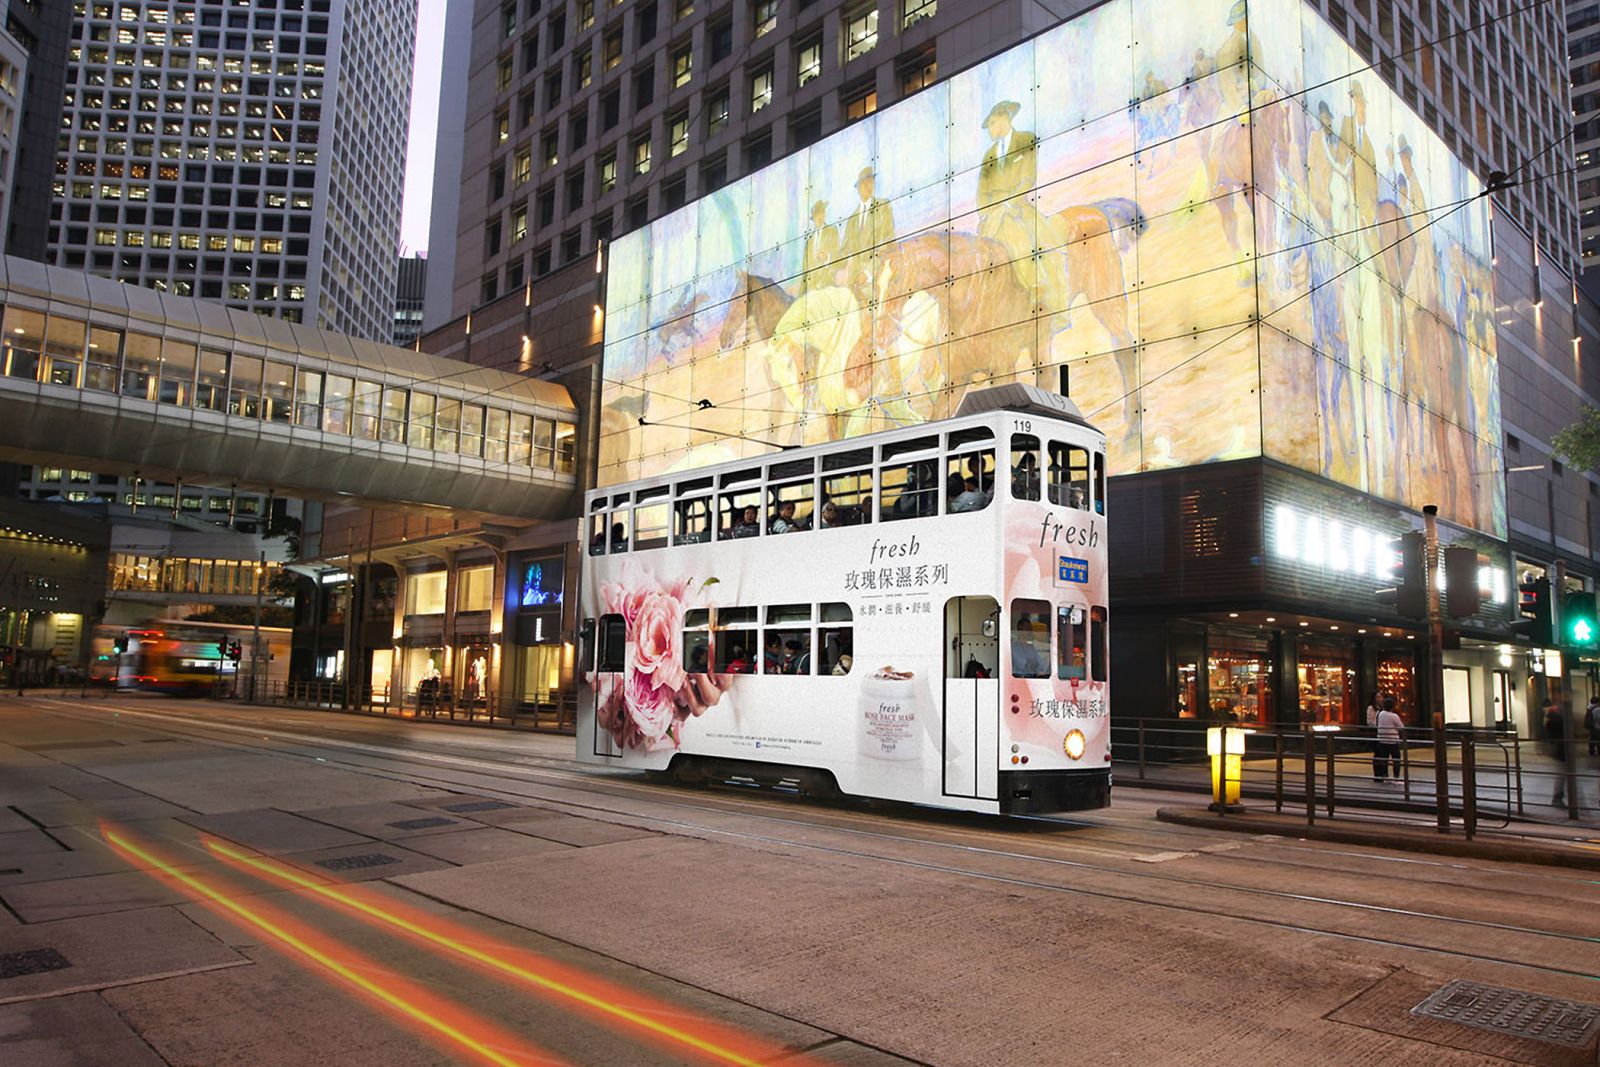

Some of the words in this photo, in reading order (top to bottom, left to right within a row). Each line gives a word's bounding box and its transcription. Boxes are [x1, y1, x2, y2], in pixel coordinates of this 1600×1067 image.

[1014, 419, 1032, 433] 119
[1040, 512, 1098, 548] fresh
[870, 535, 920, 565] fresh
[844, 563, 949, 591] 玫瑰保濕系列
[879, 702, 901, 714] fresh
